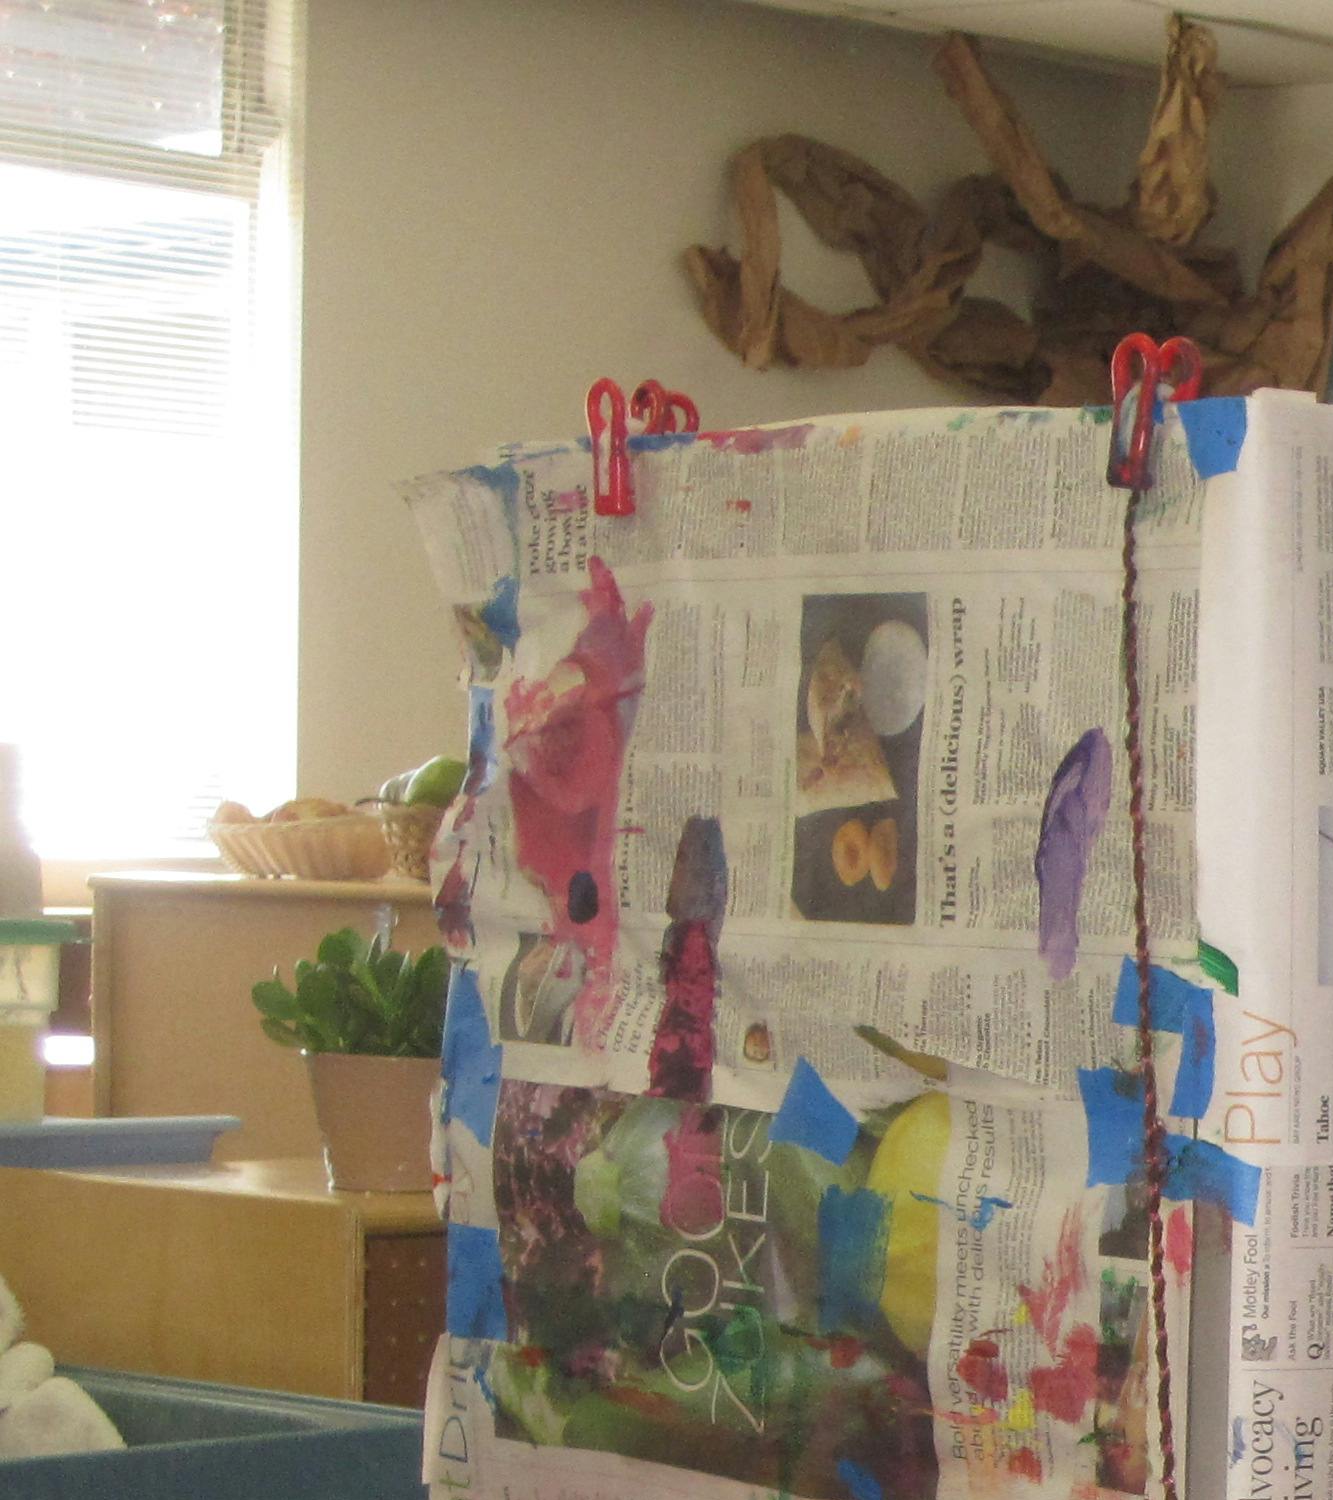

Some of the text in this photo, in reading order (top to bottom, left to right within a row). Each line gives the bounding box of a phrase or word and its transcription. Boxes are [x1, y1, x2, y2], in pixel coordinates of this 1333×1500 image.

[938, 597, 967, 928] That's a (delicious) wrap
[1223, 1010, 1297, 1146] Play
[978, 1104, 996, 1180] results
[1315, 1095, 1330, 1145] Tahoe
[954, 1101, 981, 1223] unchecked
[950, 1228, 969, 1298] meets
[968, 1183, 990, 1283] delicous
[965, 1286, 982, 1333] with
[1242, 1234, 1260, 1319] Motley Fool
[1306, 1342, 1325, 1360] Q
